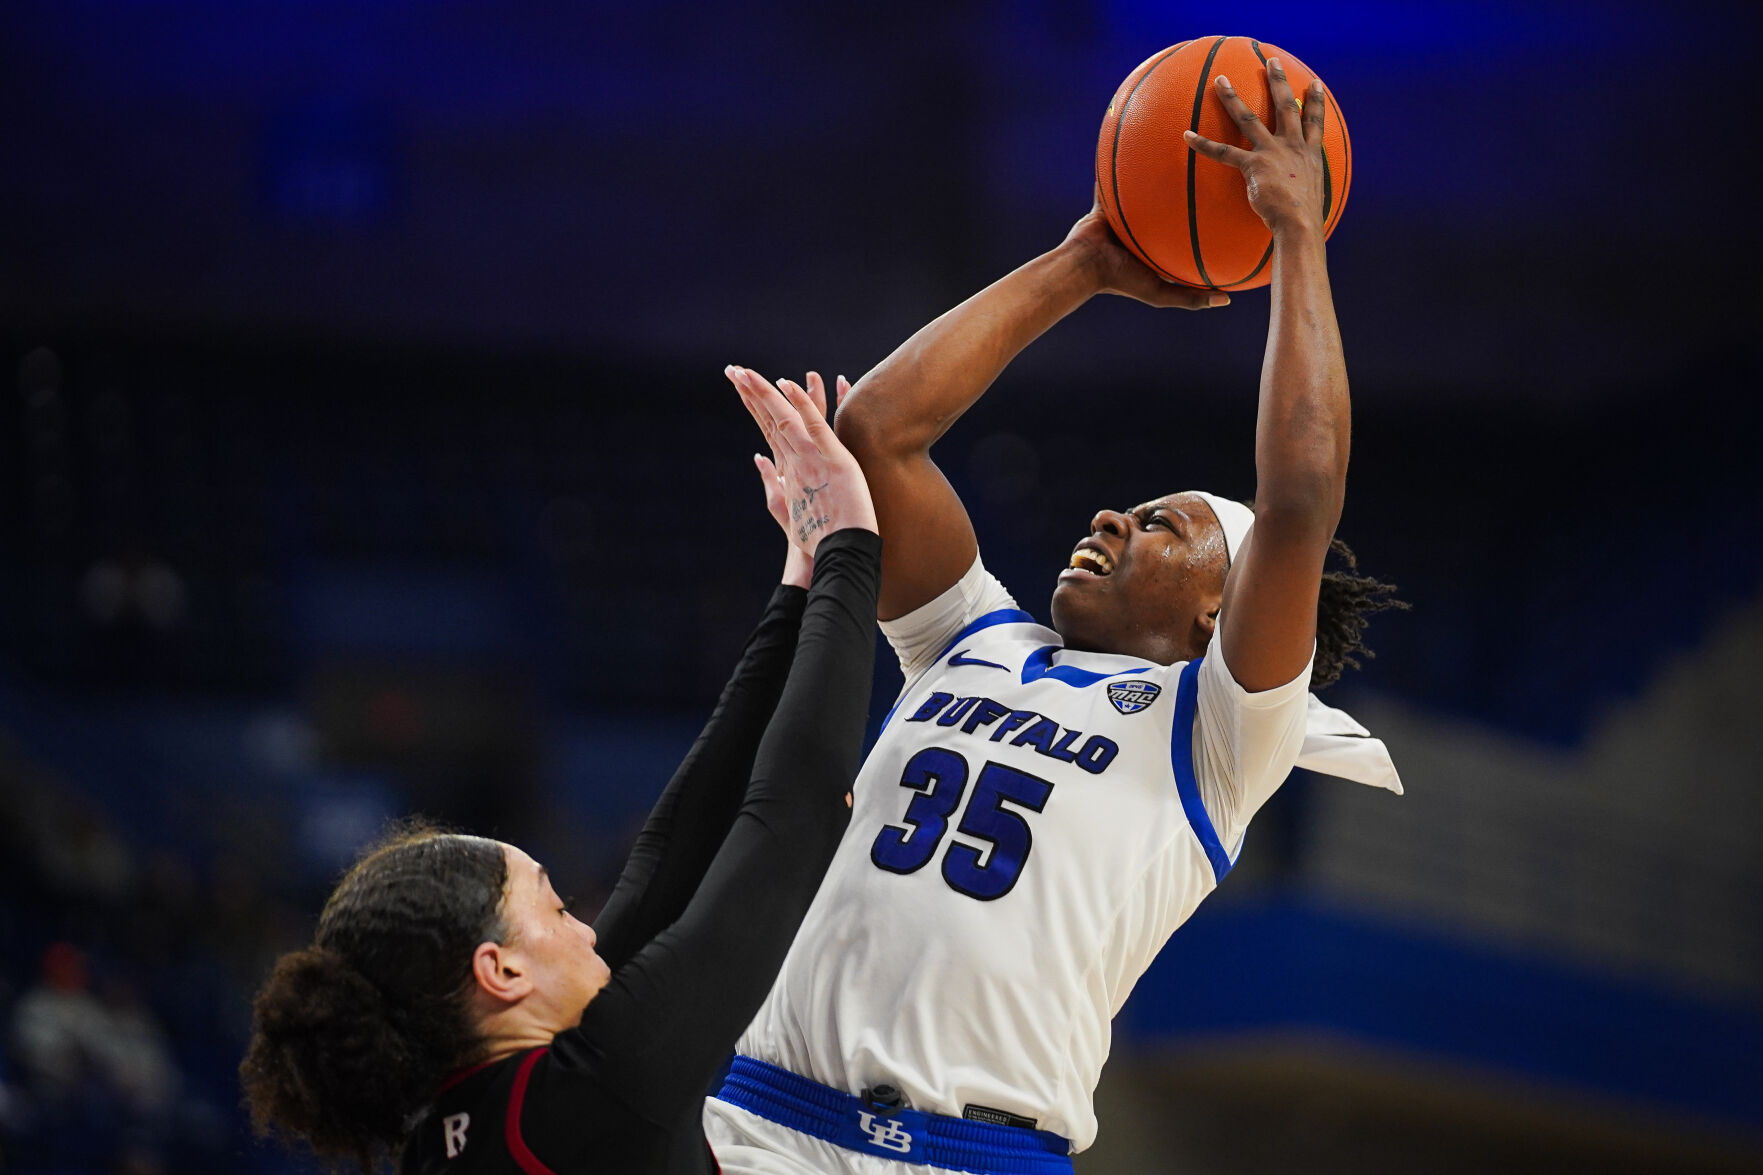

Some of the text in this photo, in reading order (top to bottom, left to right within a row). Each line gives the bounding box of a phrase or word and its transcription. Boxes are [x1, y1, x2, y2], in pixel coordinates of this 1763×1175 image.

[904, 692, 1119, 775] BUFFALO
[870, 746, 1055, 901] 35
[443, 1111, 470, 1159] R
